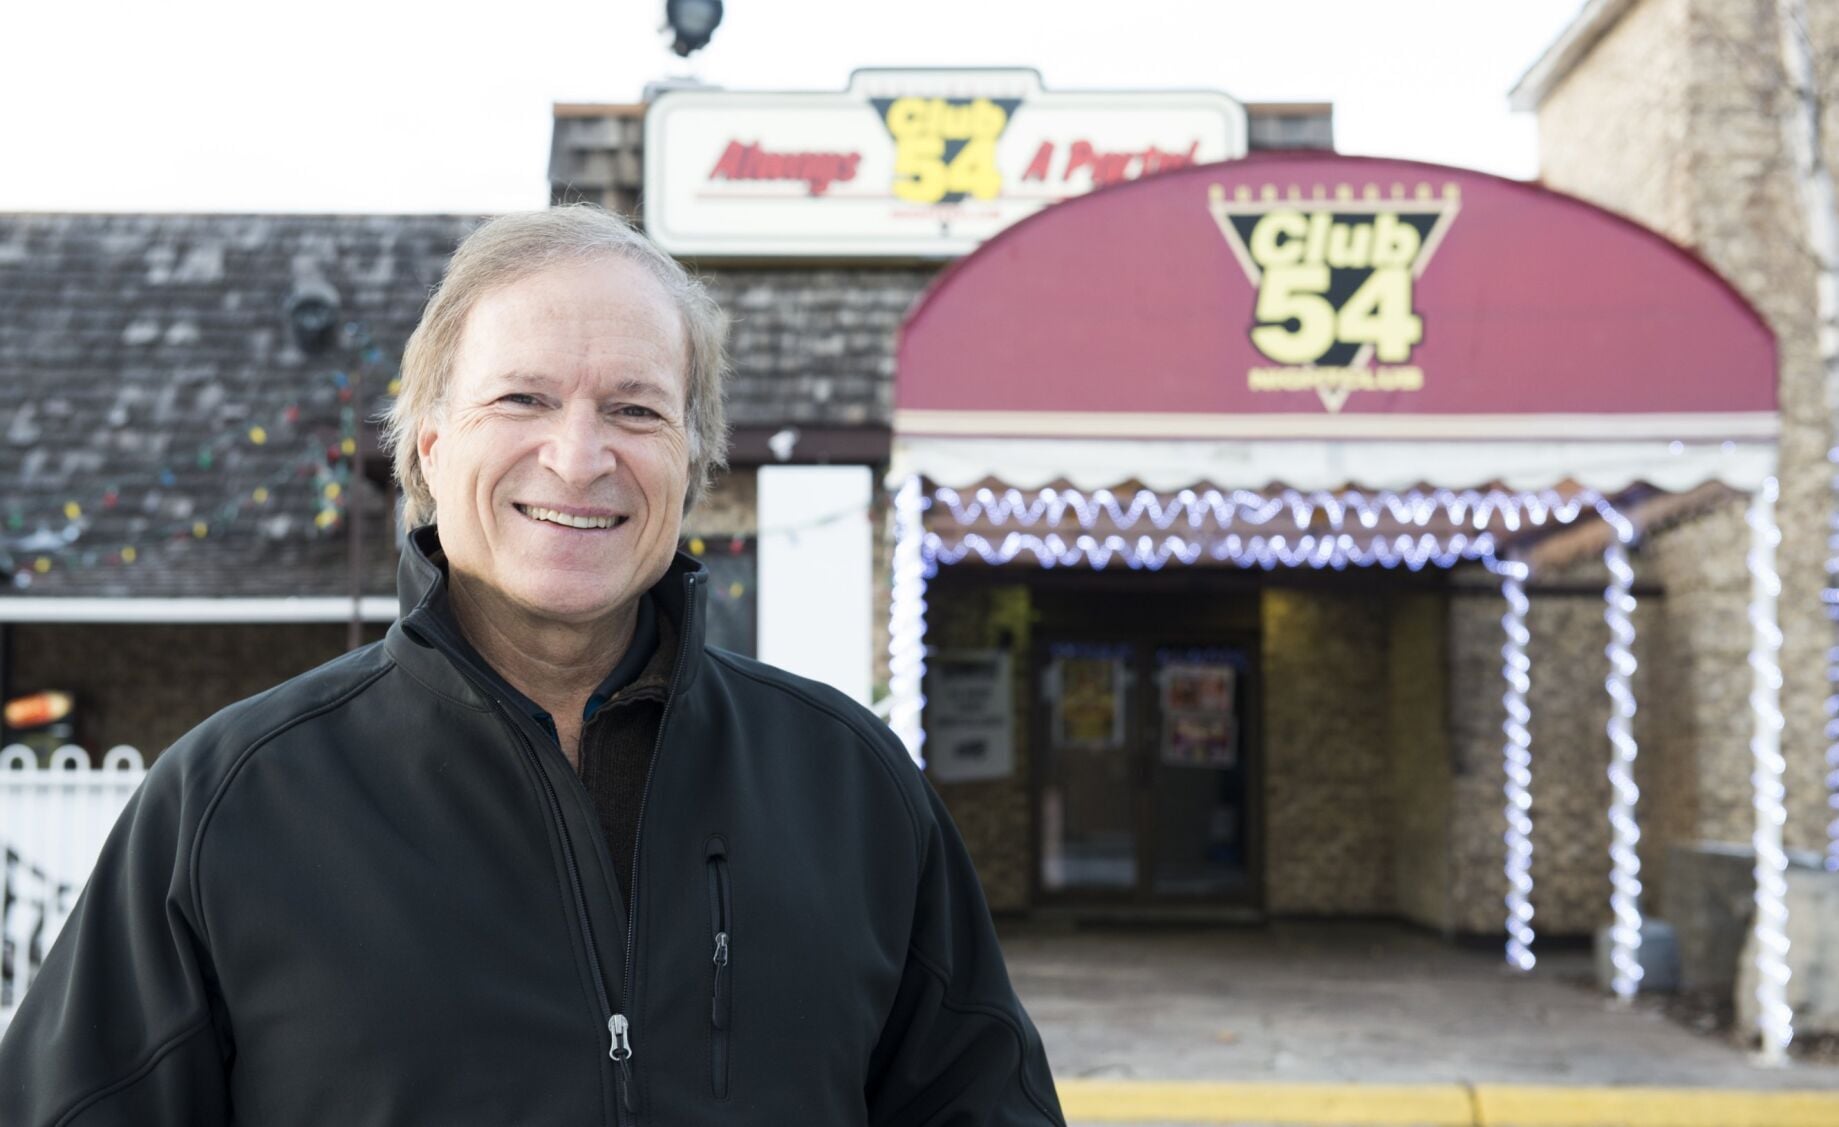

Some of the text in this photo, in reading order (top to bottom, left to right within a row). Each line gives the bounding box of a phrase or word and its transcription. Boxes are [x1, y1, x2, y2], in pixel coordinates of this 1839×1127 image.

[887, 97, 1007, 140] Club
[892, 137, 1002, 203] 54
[1021, 140, 1055, 182] A
[1250, 209, 1421, 268] Club
[1250, 265, 1423, 364] 54
